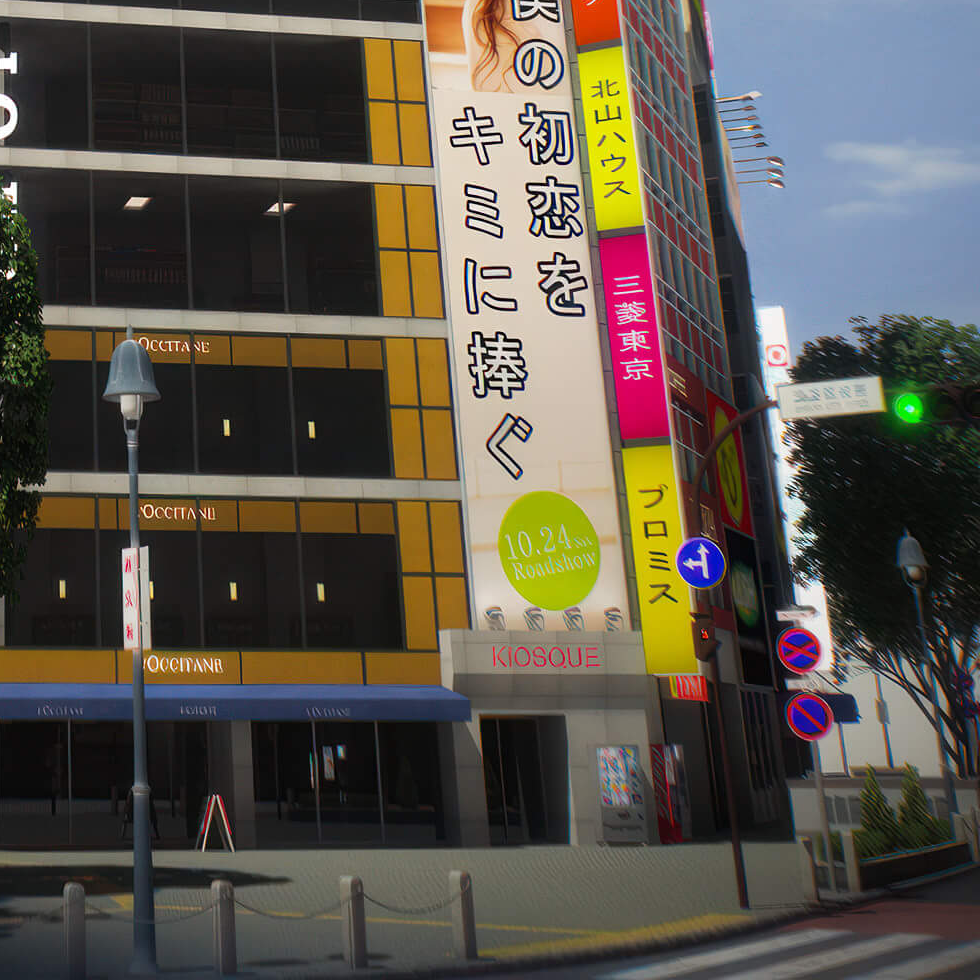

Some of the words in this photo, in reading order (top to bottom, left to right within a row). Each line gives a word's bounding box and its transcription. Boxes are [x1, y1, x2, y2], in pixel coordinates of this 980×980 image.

[590, 78, 633, 199] 北山ハウス
[449, 106, 534, 480] キミに捧ぐ
[612, 274, 655, 381] 三菱東京
[511, 551, 596, 581] Roadshow
[491, 645, 602, 669] KIOSQUE
